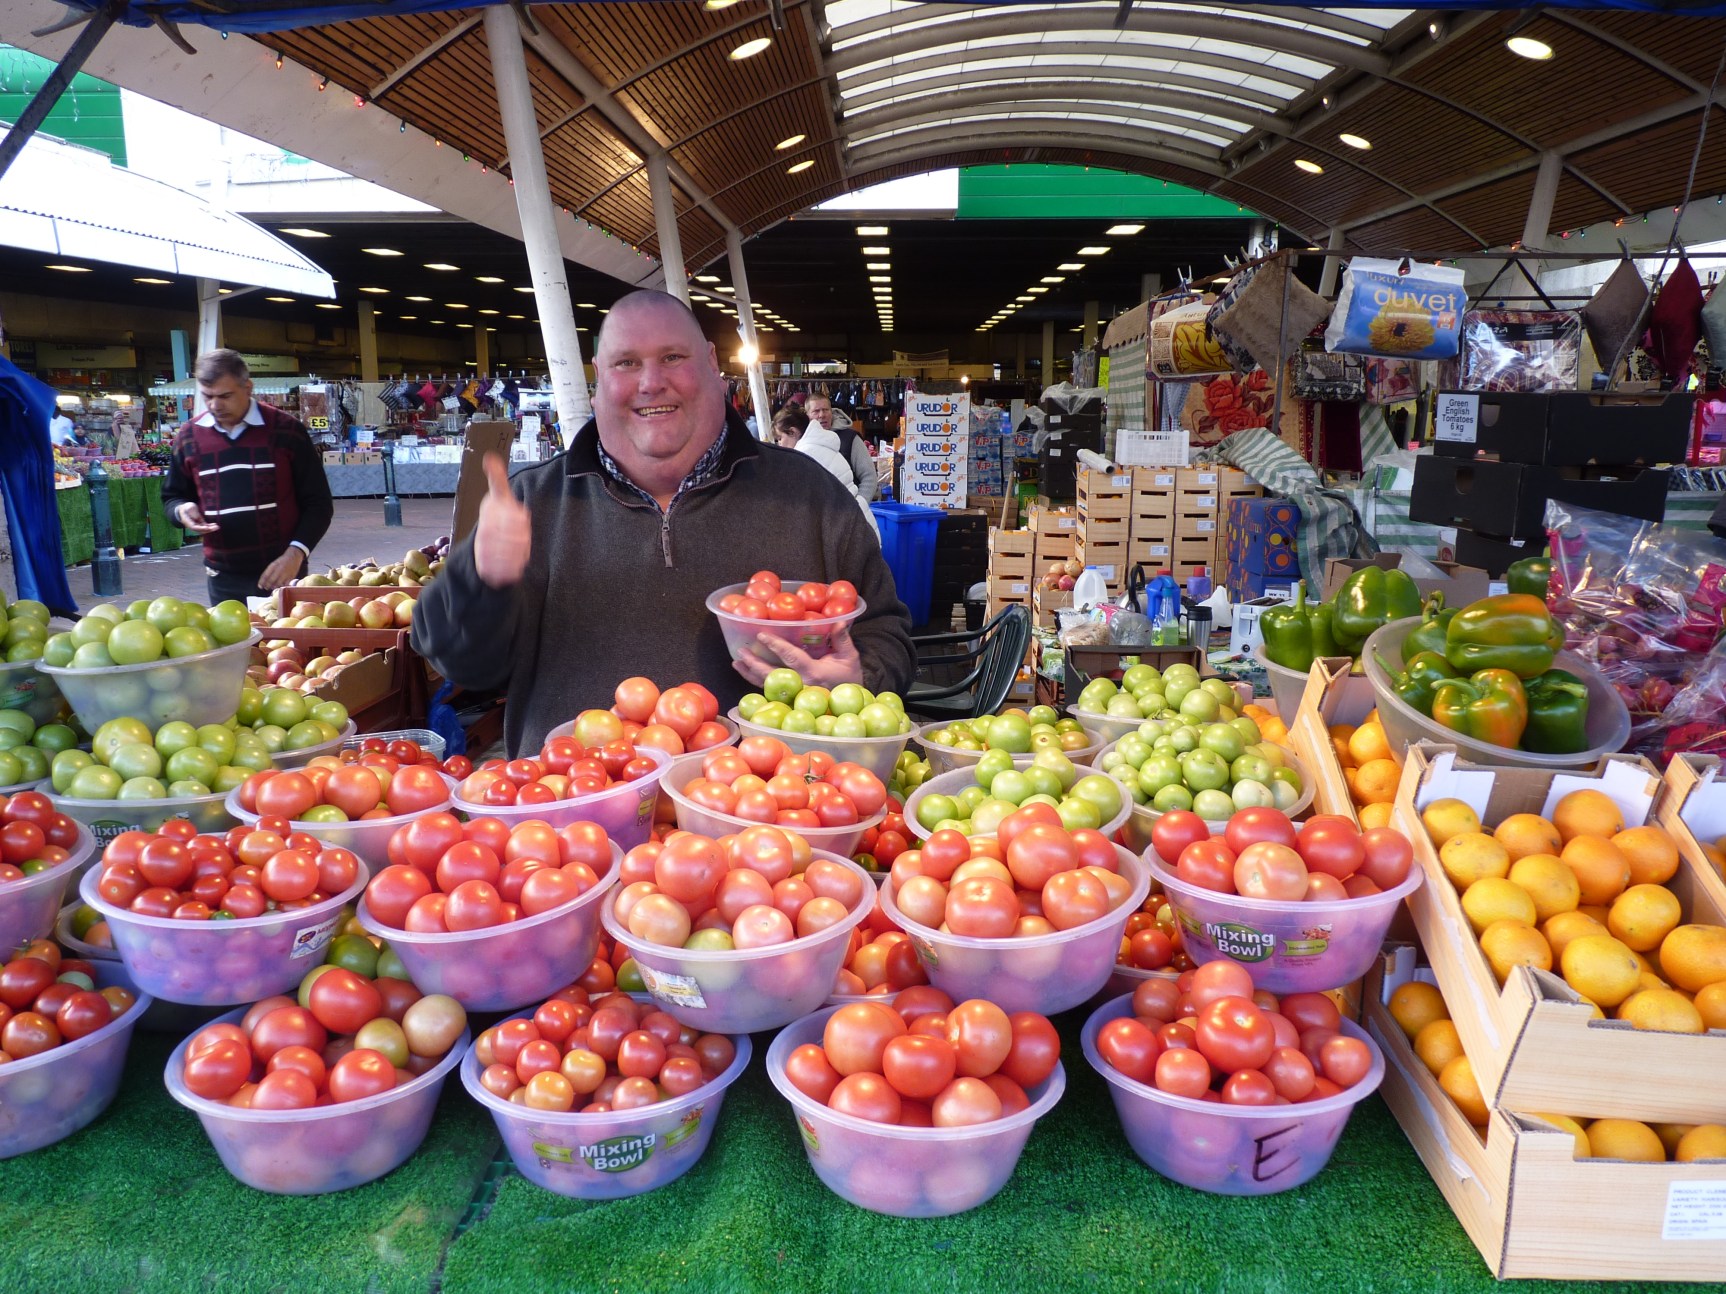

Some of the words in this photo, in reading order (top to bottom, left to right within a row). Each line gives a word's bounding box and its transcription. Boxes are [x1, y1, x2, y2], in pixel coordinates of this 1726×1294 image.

[1374, 287, 1456, 312] duvet
[1445, 406, 1470, 416] English
[1449, 399, 1469, 407] Green
[311, 418, 327, 427] £5
[1442, 413, 1474, 423] Tomatoes
[1450, 422, 1455, 430] 6
[1456, 423, 1464, 432] kg
[1206, 923, 1275, 947] Mixing
[1218, 939, 1262, 957] Bowl
[579, 1133, 656, 1158] Mixing
[1252, 1122, 1303, 1182] E
[594, 1148, 643, 1171] Bowl
